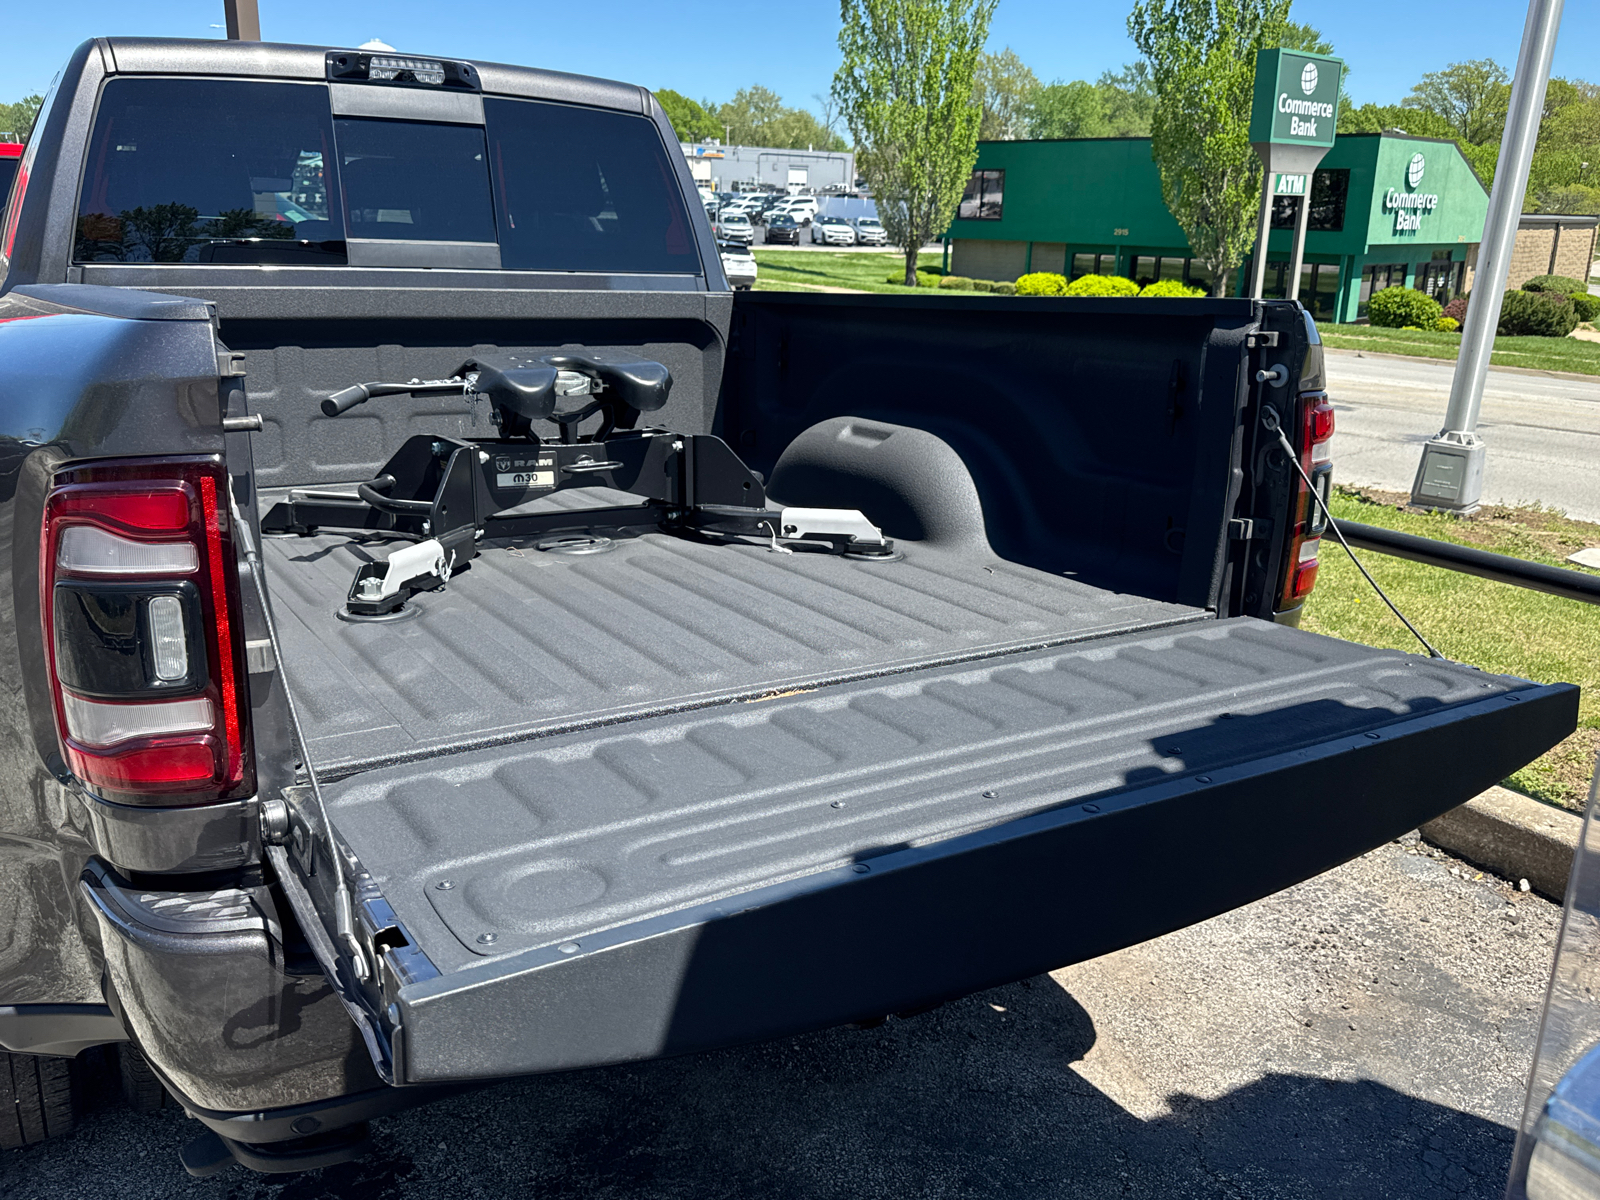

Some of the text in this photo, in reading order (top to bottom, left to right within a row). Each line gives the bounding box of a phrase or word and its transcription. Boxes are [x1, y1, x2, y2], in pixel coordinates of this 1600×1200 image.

[1278, 93, 1333, 118] Commerce
[1290, 116, 1317, 137] Bank
[1277, 175, 1304, 194] ATM
[1386, 187, 1438, 209] Commerce
[1396, 210, 1422, 230] Bank
[514, 459, 553, 467] RAM
